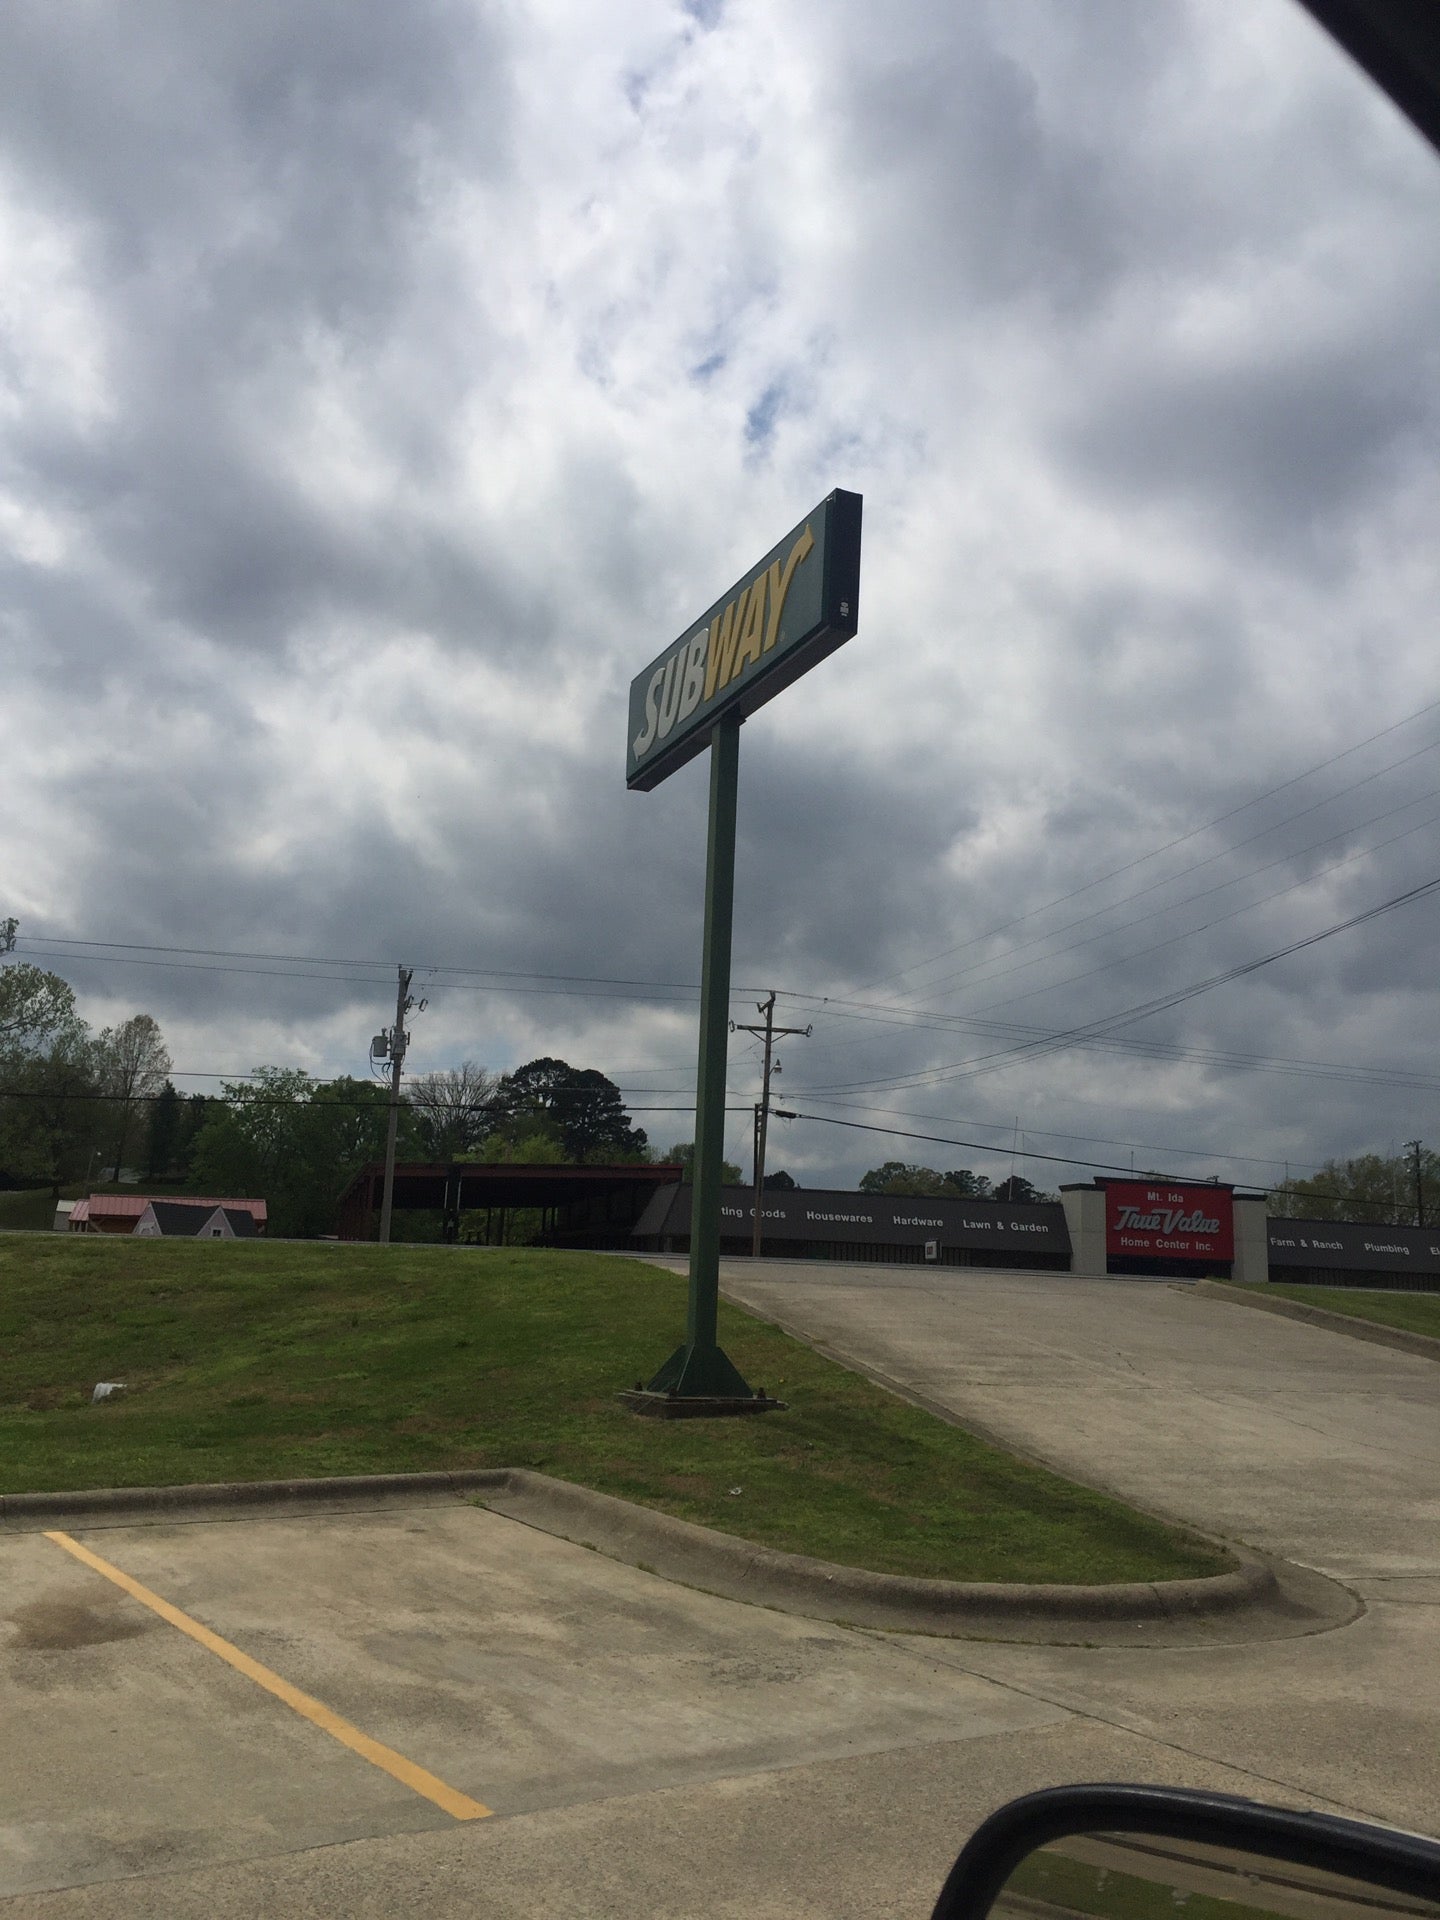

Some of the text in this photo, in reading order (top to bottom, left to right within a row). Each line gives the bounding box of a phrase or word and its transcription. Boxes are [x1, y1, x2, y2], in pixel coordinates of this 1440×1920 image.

[633, 523, 815, 762] SUBWAY
[1168, 1192, 1184, 1203] Ida
[806, 1210, 873, 1223] Housewares
[893, 1215, 944, 1227] Hardware
[963, 1219, 1049, 1233] Lawn & Garden
[1120, 1237, 1215, 1251] Home Center Inc.
[1270, 1237, 1344, 1250] Farm & Ranch
[1364, 1243, 1410, 1255] Plumbing
